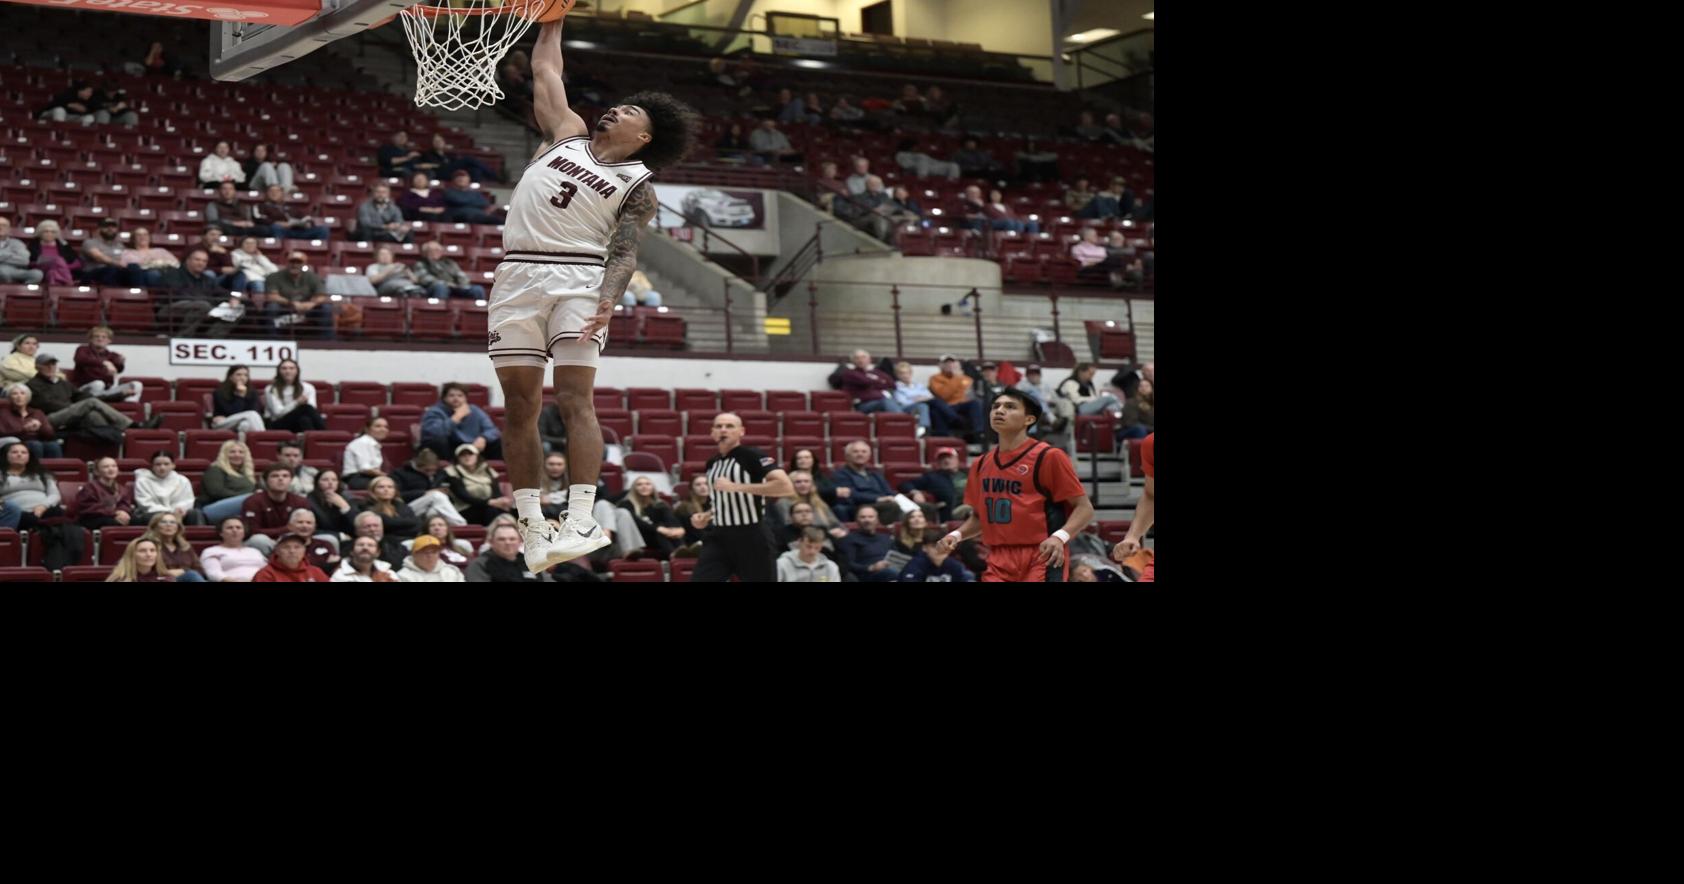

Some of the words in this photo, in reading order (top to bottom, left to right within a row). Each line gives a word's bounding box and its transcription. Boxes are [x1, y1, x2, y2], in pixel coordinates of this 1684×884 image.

[547, 156, 618, 199] MONTANA
[550, 181, 578, 209] 3
[175, 344, 236, 360] SEC.
[247, 345, 292, 361] 110
[985, 497, 1012, 524] 10
